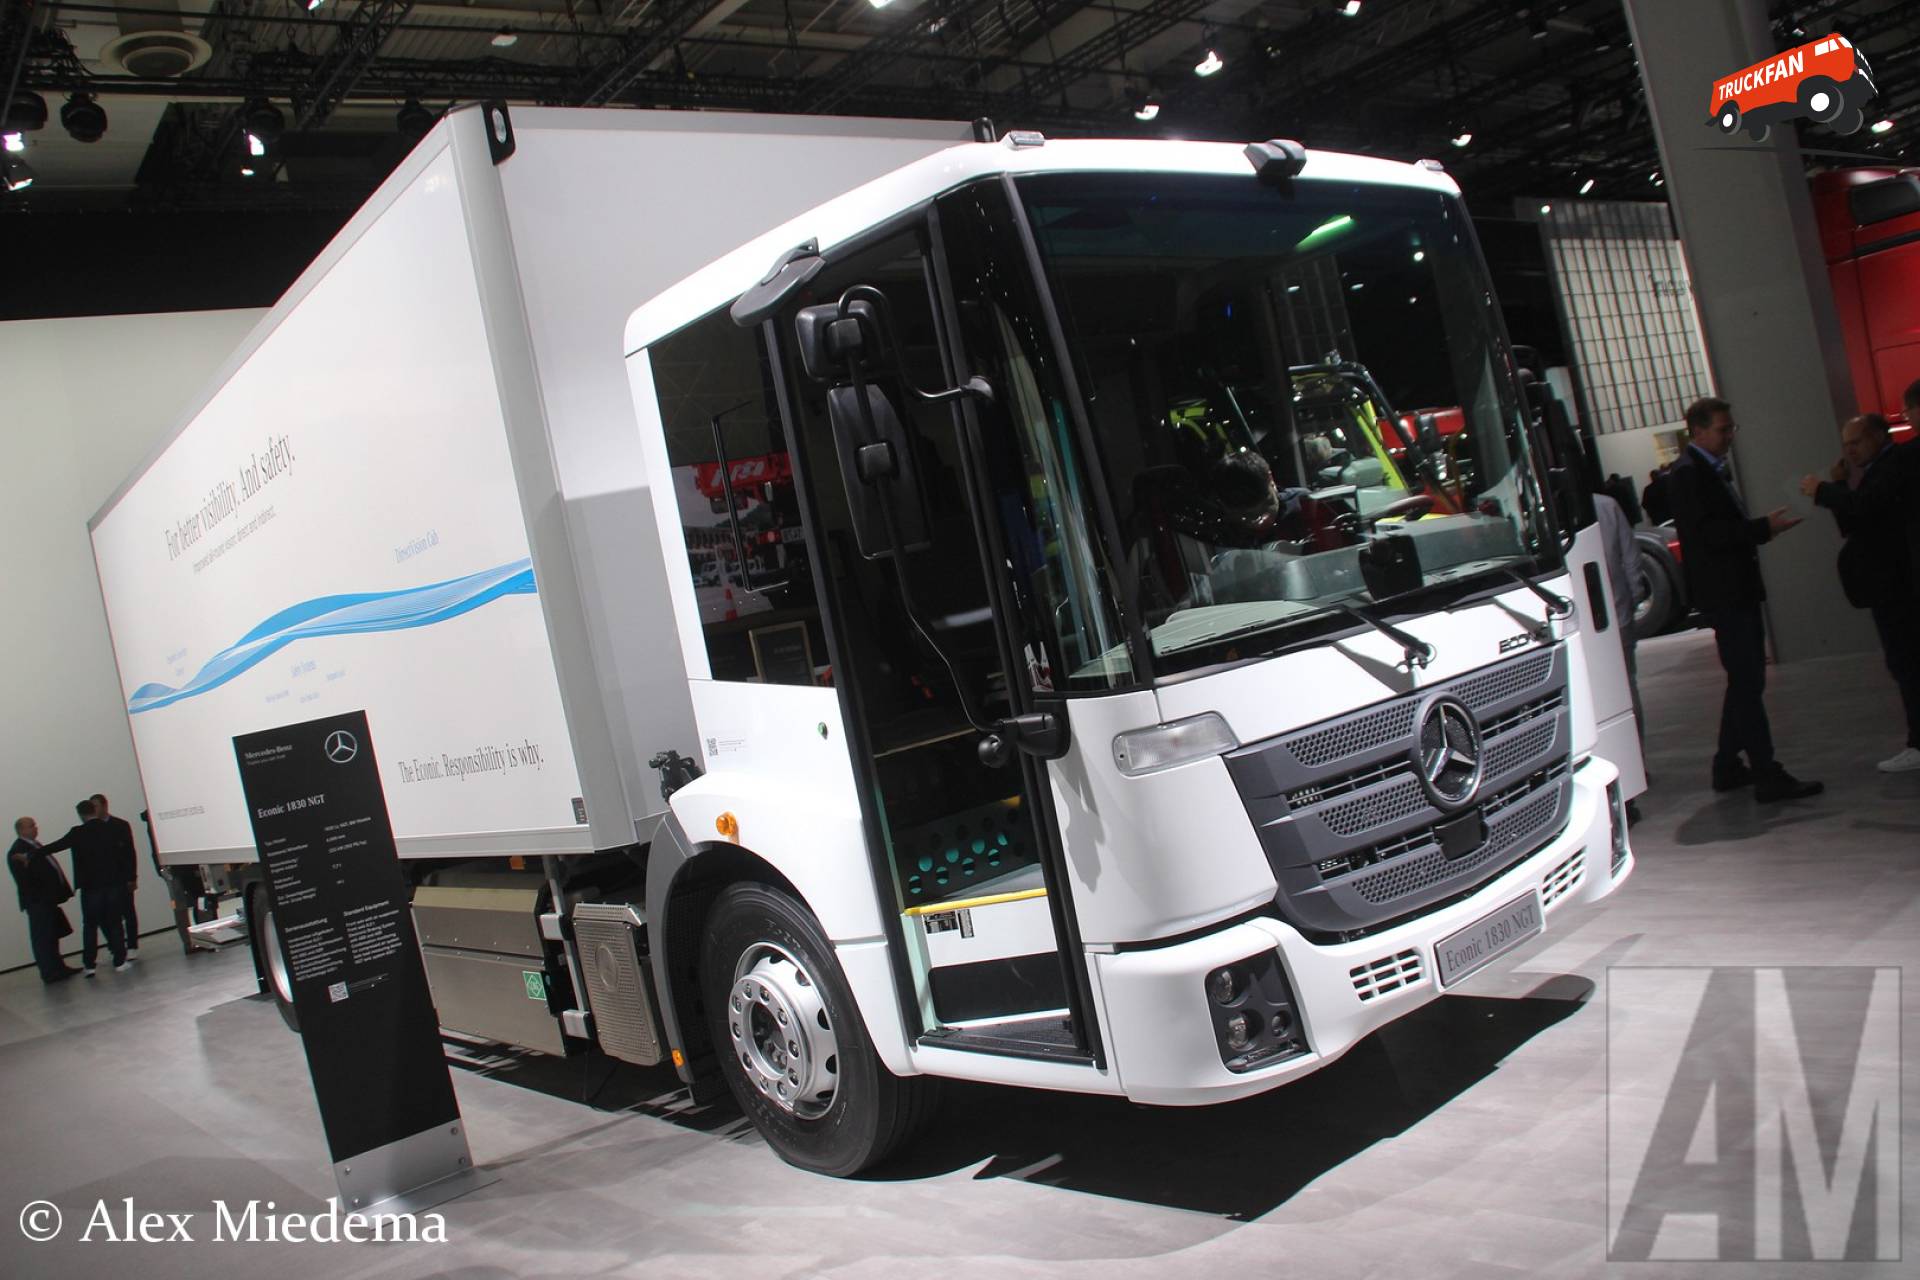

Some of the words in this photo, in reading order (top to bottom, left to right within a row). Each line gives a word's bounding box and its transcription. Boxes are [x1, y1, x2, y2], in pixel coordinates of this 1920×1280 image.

[164, 529, 182, 561] For
[177, 514, 202, 551] better
[199, 480, 241, 531] visibility.
[239, 452, 262, 502] And
[259, 432, 296, 485] safety.
[398, 760, 415, 783] The
[412, 756, 445, 782] Econic.
[441, 745, 506, 782] Responsibility
[505, 742, 519, 769] is
[517, 738, 544, 771] why.
[257, 803, 286, 819] Econic
[285, 797, 308, 813] 1830
[307, 793, 326, 807] NGT
[1445, 938, 1483, 972] Econic
[1484, 919, 1512, 949] 1830
[1511, 903, 1535, 934] NGT
